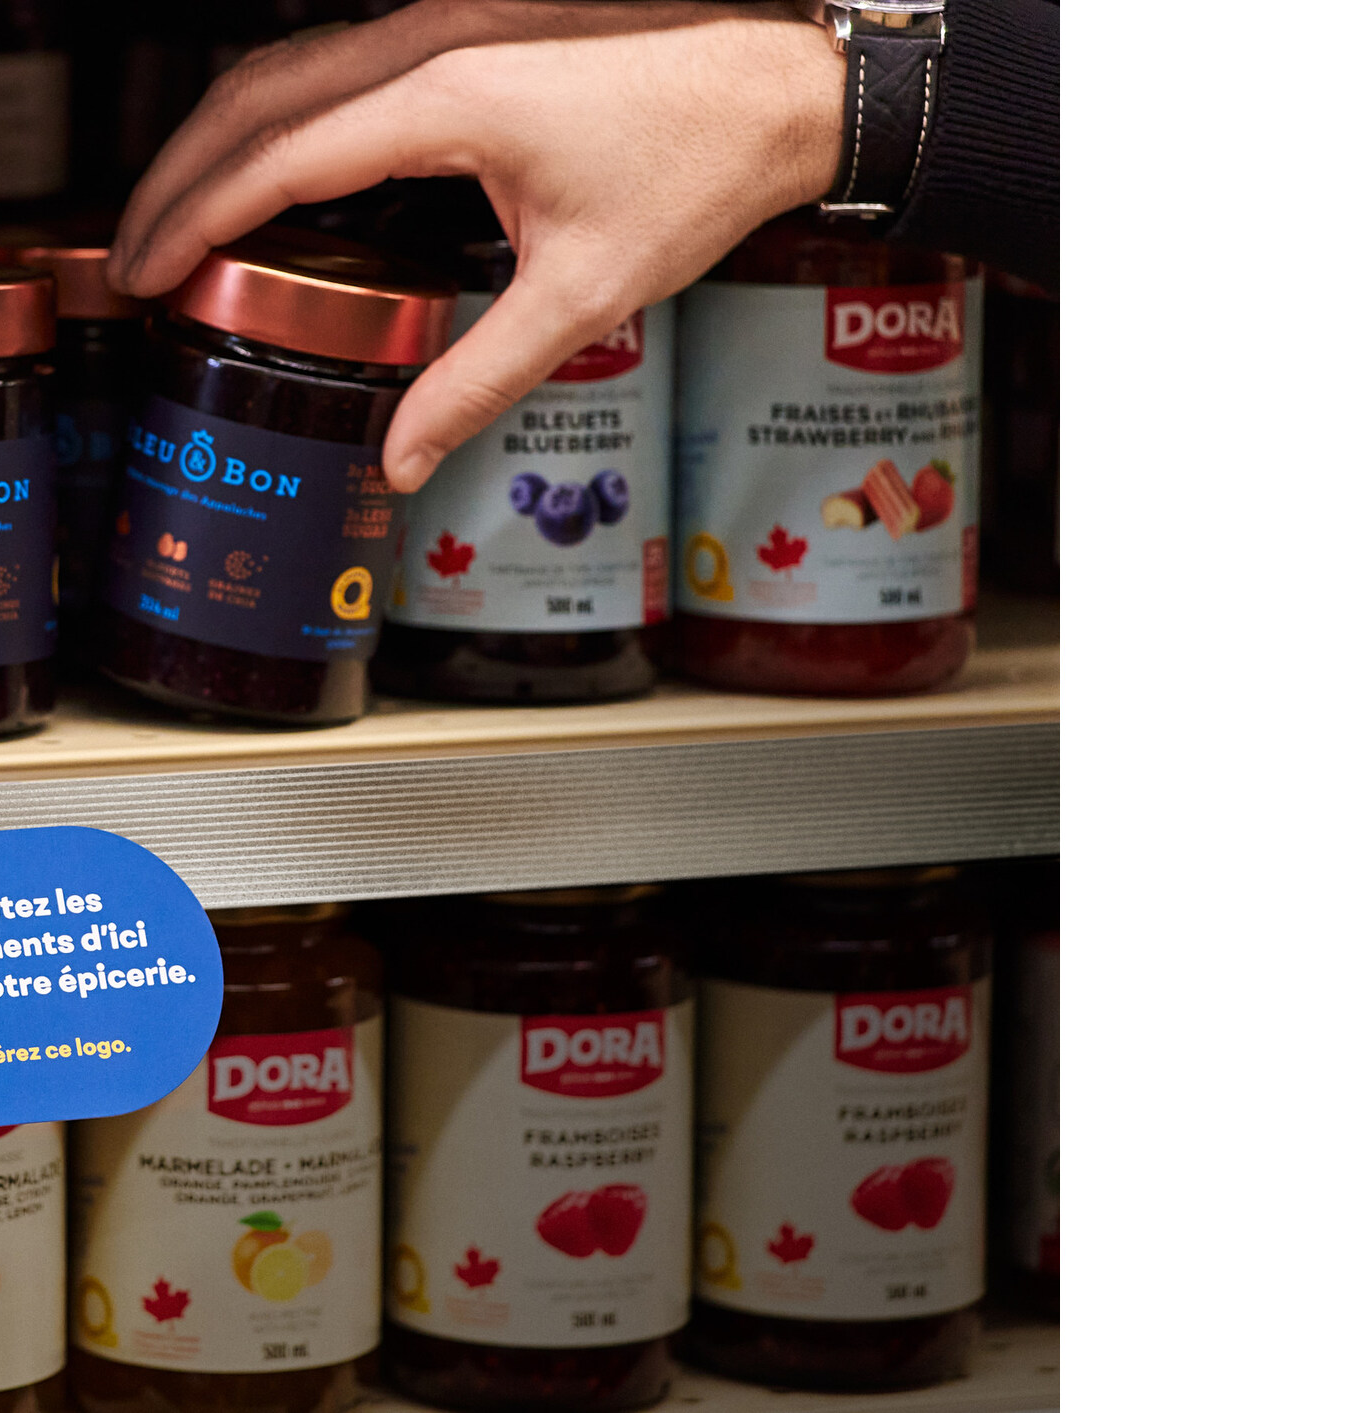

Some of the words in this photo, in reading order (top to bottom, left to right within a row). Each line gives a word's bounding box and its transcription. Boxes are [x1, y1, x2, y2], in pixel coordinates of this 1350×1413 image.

[831, 296, 960, 350] DORA
[522, 408, 623, 431] BLEUETS
[771, 402, 870, 422] FRAISES
[503, 431, 634, 453] BLUEBERRY
[747, 424, 908, 446] STRAWBERRY
[221, 456, 302, 498] BON
[55, 888, 103, 915] les
[80, 920, 148, 952] d'ici
[58, 957, 197, 999] épicerie.
[840, 995, 967, 1053] DORA
[45, 1043, 72, 1060] ce
[75, 1037, 132, 1060] logo.
[525, 1020, 661, 1076] DORA
[212, 1046, 350, 1103] DORA
[524, 1121, 661, 1145] FRAMBOISES
[139, 1155, 277, 1176] MARMELADE
